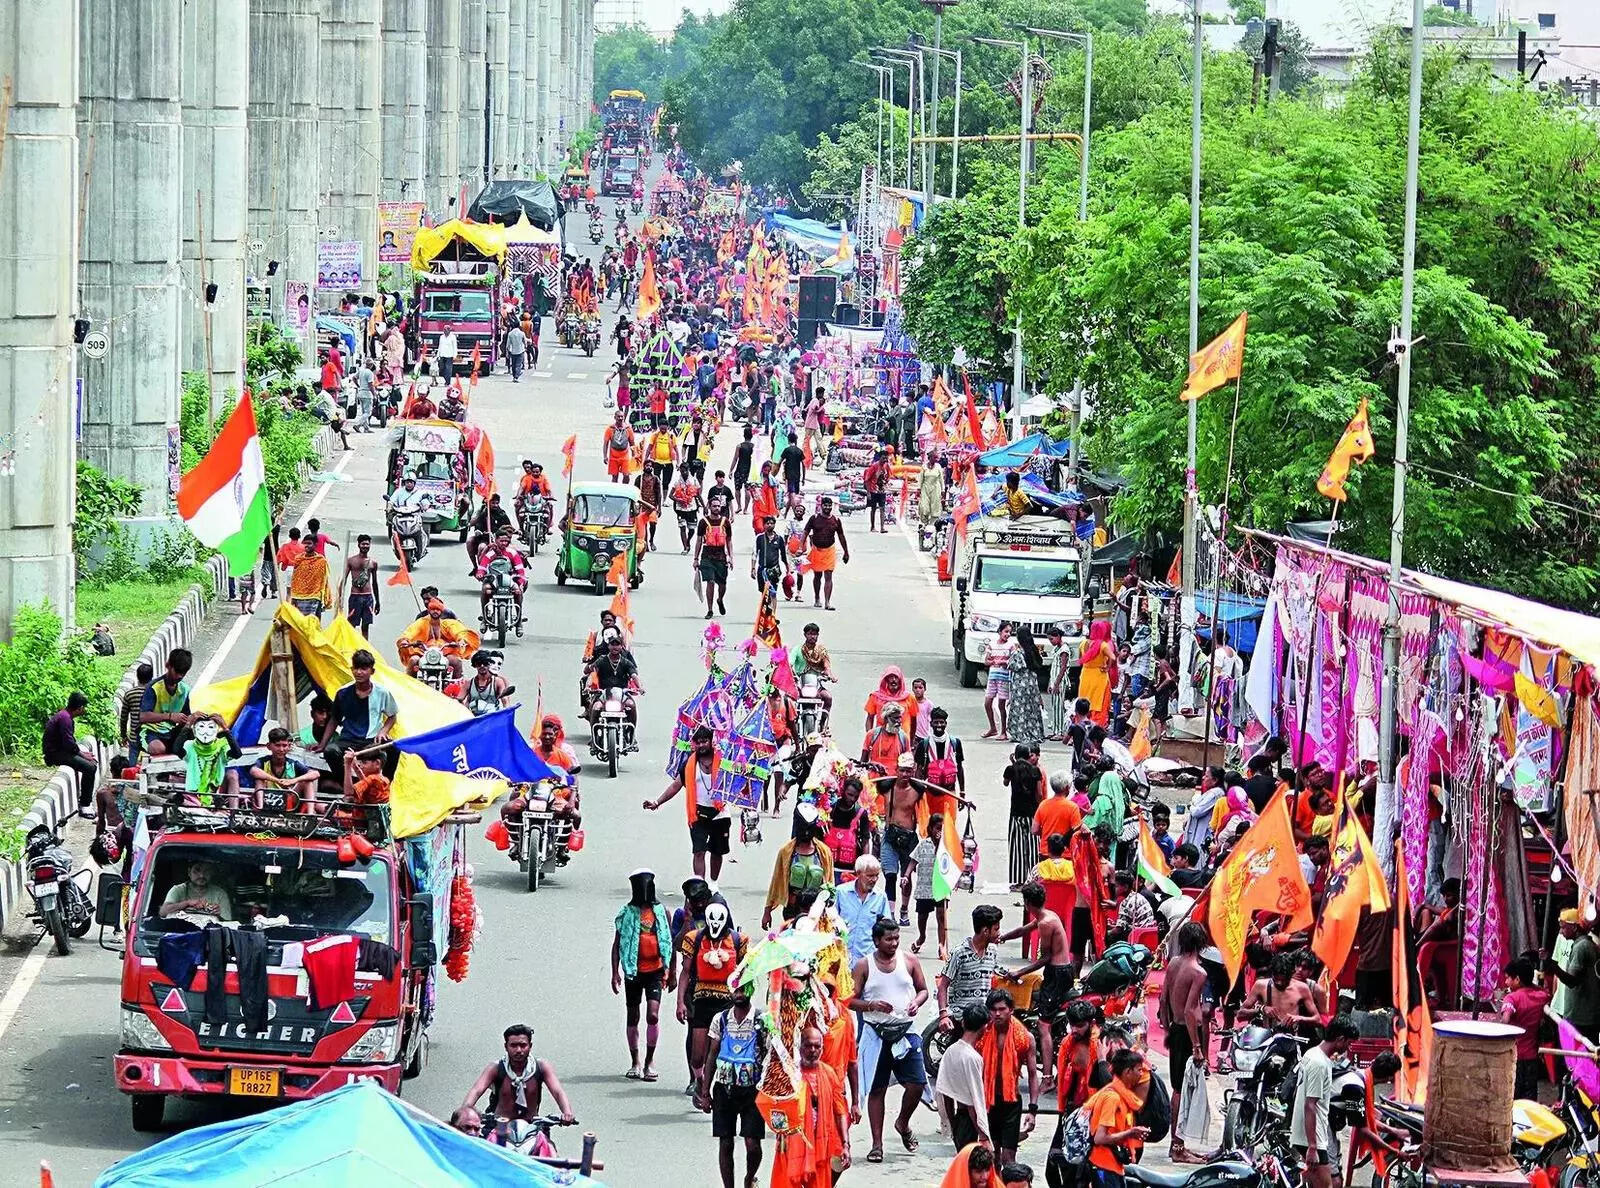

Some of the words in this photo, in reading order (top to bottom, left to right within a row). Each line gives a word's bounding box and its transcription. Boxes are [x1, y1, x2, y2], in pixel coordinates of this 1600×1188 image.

[87, 340, 106, 350] 509
[199, 1021, 316, 1043] EICHER
[240, 1069, 272, 1082] UP16E
[240, 1082, 272, 1094] T8827
